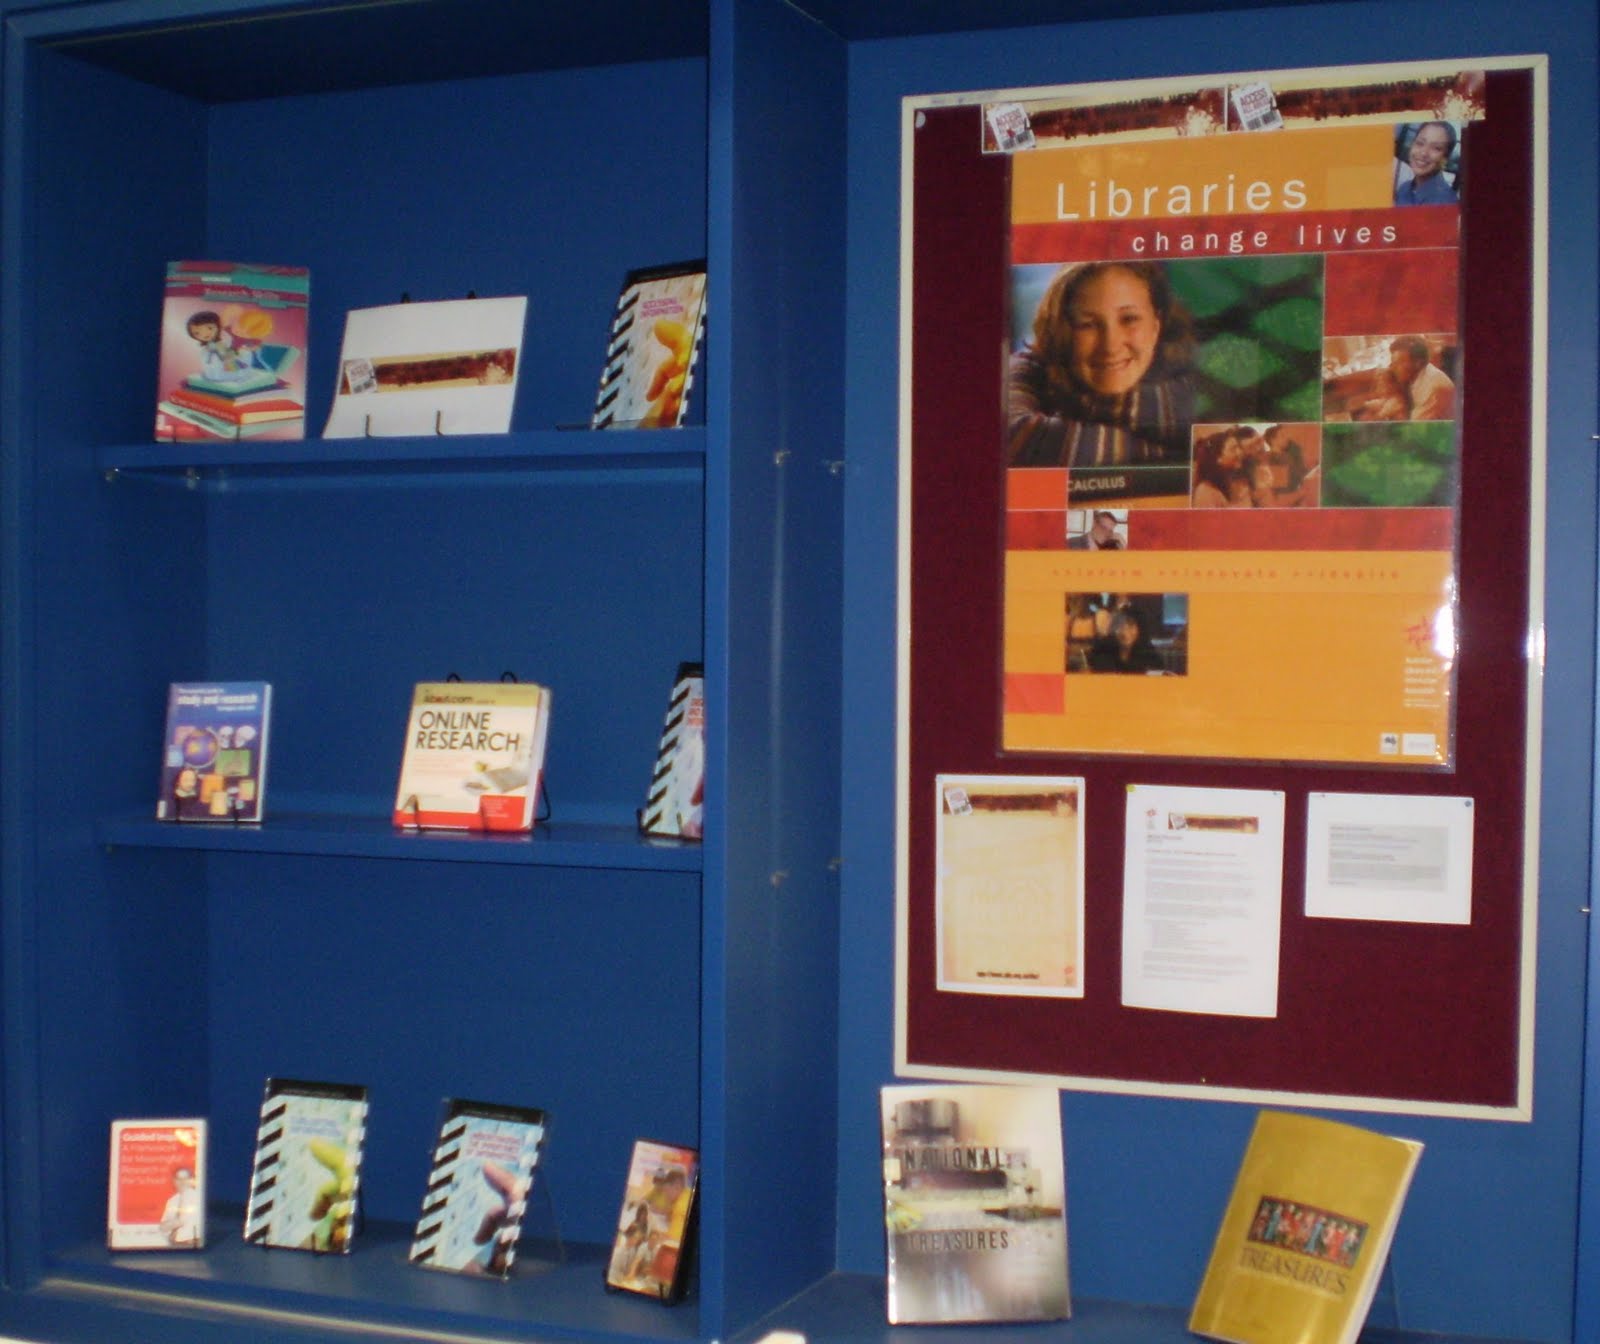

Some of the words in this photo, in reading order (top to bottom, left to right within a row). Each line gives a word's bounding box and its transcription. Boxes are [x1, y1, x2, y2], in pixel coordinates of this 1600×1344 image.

[1056, 175, 1308, 220] Libraries
[1132, 229, 1269, 254] change
[1299, 223, 1397, 246] lives
[1067, 476, 1126, 492] CALCULUS
[419, 710, 492, 731] ONLINE
[415, 730, 521, 752] RESEARCH
[904, 1147, 1006, 1169] NATIONAL
[908, 1230, 1010, 1250] TREASURES
[1240, 1247, 1350, 1296] TREASURES
